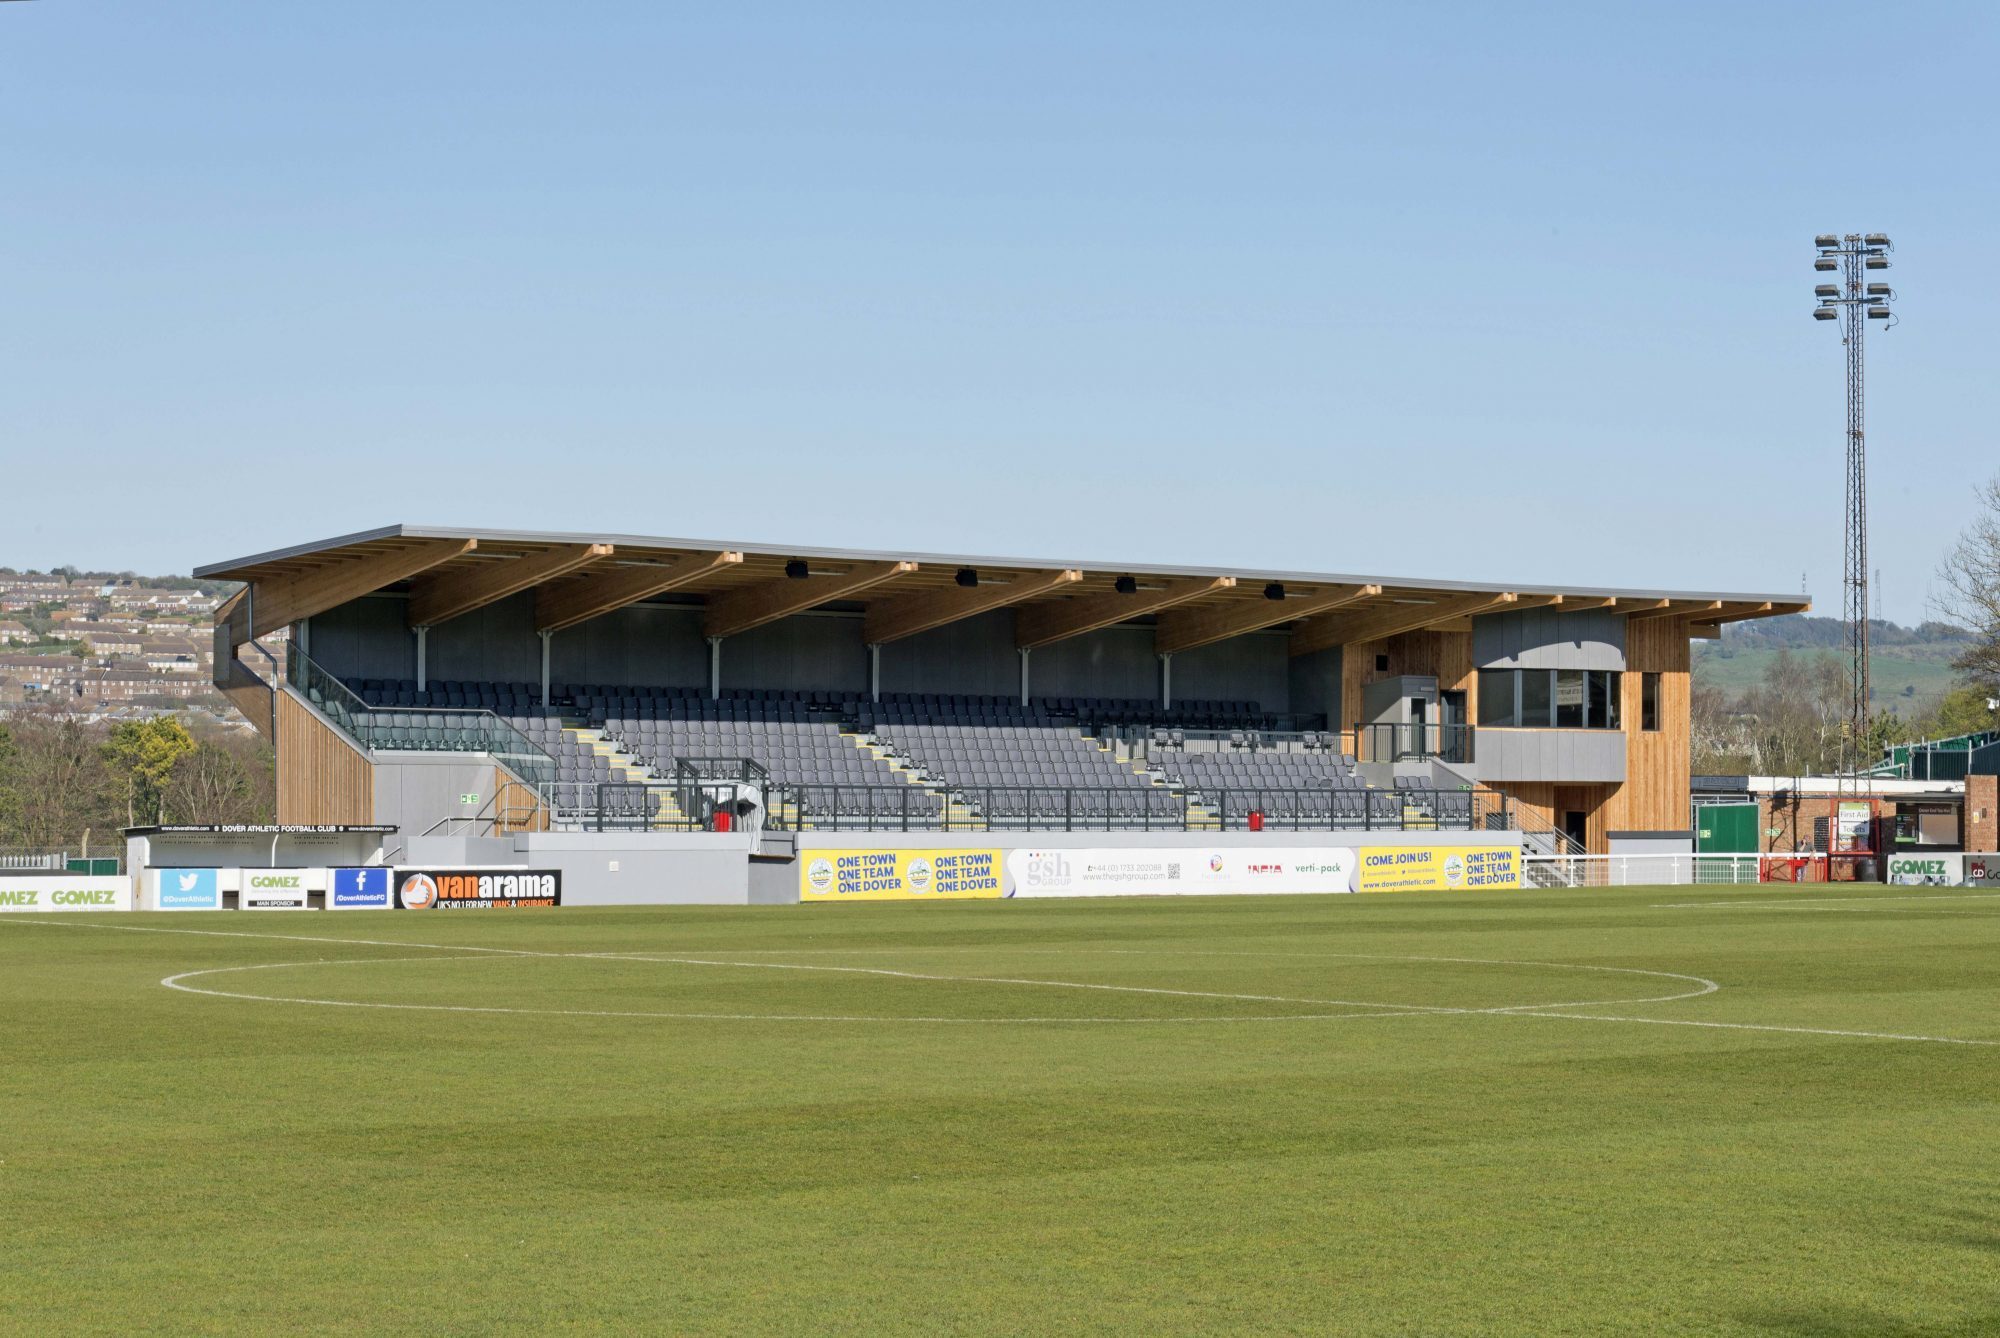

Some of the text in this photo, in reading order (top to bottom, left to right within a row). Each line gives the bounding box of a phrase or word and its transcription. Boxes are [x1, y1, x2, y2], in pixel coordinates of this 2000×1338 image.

[836, 854, 896, 868] ONE TOWN
[935, 854, 993, 868] ONE TOWN
[1366, 852, 1432, 867] COME JOIN US!
[1466, 851, 1512, 864] ONE TOWN
[837, 866, 894, 881] ONE TEAM
[935, 866, 990, 881] ONE TEAM
[1027, 852, 1072, 886] gsh
[1120, 864, 1135, 872] 1733
[1295, 862, 1341, 875] verti-pack
[1467, 863, 1511, 875] ONE TEAM
[1889, 859, 1946, 875] GOMEZ
[250, 876, 300, 888] GOMEZ
[1041, 878, 1072, 887] GROUP
[1082, 872, 1166, 882] www.thegshgroup.com
[1363, 878, 1436, 889] www.doverathletic.com
[1467, 873, 1516, 886] ONE DOVER
[436, 874, 555, 899] vanarama
[838, 878, 902, 894] ONE DOVER
[936, 878, 998, 893] ONE DOVER
[51, 890, 116, 905] GOMEZ
[163, 895, 214, 904] @DoverAthletic
[336, 894, 385, 902] /DoverAthleticFC
[465, 900, 477, 908] FOR
[477, 900, 492, 908] NEW
[493, 899, 511, 908] VANS
[511, 899, 516, 908] &
[517, 899, 554, 907] INSURANCE
